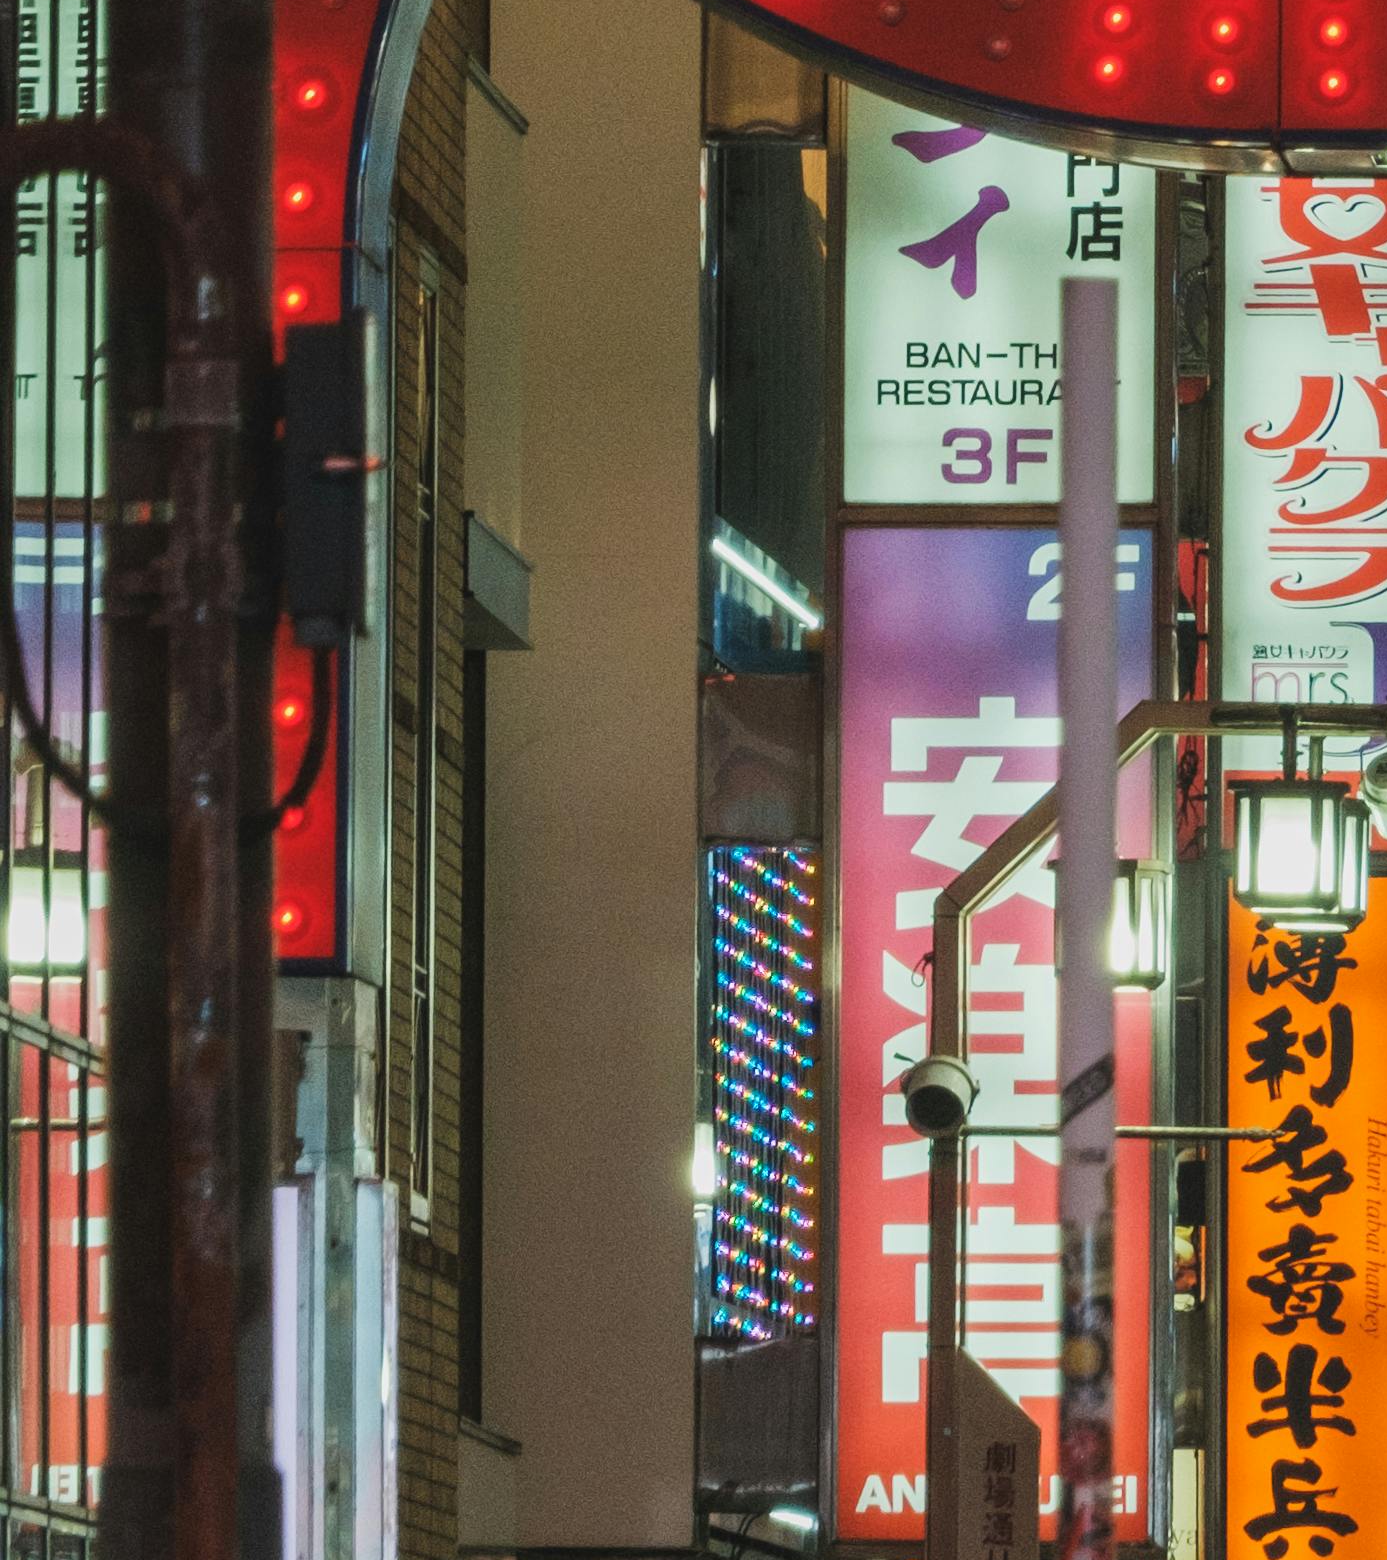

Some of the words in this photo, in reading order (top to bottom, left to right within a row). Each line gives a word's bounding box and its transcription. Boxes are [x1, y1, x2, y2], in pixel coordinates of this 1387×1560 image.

[904, 342, 1058, 371] BAN-TH
[876, 379, 1063, 407] RESTAURA
[940, 427, 1055, 486] 3F
